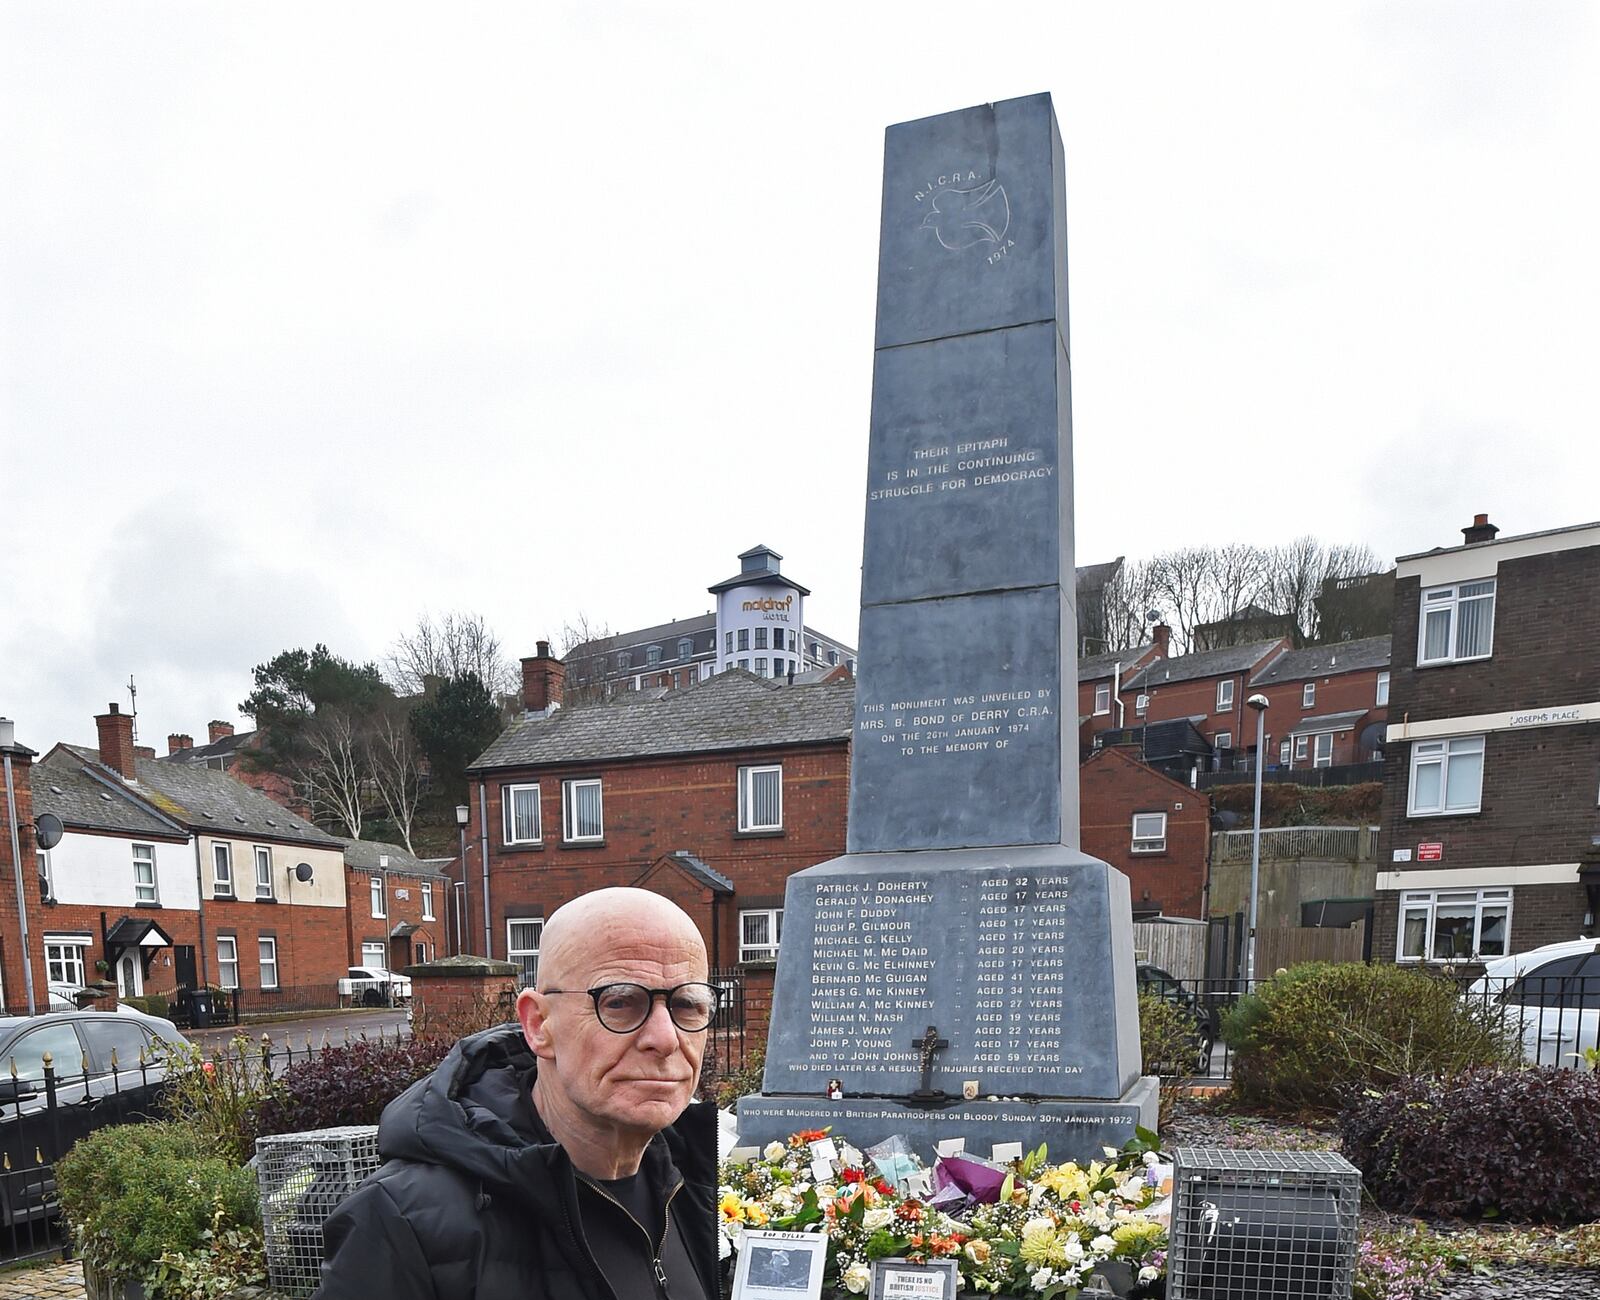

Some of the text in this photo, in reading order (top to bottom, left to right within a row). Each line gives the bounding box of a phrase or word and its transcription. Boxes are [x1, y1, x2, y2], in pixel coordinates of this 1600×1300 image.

[986, 239, 1015, 266] 1974
[913, 438, 1009, 459] THEIR EPITAPH
[887, 451, 1036, 481] IS IN THE CONTINUING
[870, 466, 1055, 501] STRUGGLE FOR DEMOCRACY
[863, 689, 1052, 713] THIS MONUMENT WAS UNVEILED BY
[860, 706, 1053, 730] MRS. B. BOND OF DERRY C.R.A.
[1552, 711, 1575, 720] PLACE
[881, 724, 1030, 743] ON THE 26TH JANUARY 1974
[901, 740, 1009, 756] TO THE MEMORY OF
[816, 877, 1069, 893] PATRICK J. DOHERTY AGED 32 YEARS
[815, 890, 1068, 907] GERALD V. DONAGHEY AGED 17 YEARS
[815, 904, 1066, 920] JOHN F. DUDDY AGED 17 YEARS
[814, 918, 1065, 932] HUGH P. GILMOUR AGED 17 YEARS
[814, 936, 860, 946] MICHAEL
[864, 935, 876, 944] G.
[880, 934, 913, 944] KELLY
[1013, 932, 1025, 941] 17
[1031, 932, 1065, 940] YEARS
[813, 949, 859, 958] MICHAEL
[863, 948, 877, 957] M.
[902, 947, 928, 956] DAID
[978, 947, 1005, 955] AGED
[1012, 946, 1025, 954] 20
[1031, 946, 1064, 954] YEARS
[812, 962, 843, 971] KEVIN
[847, 961, 859, 970] G.
[884, 960, 936, 969] ELHINNEY
[977, 960, 1005, 968] AGED
[1011, 959, 1023, 968] 17
[1030, 959, 1063, 967] YEARS
[812, 975, 861, 984] BERNARD
[886, 974, 928, 983] GUIGAN
[1011, 973, 1023, 981] 41
[1030, 973, 1064, 981] YEARS
[811, 988, 846, 997] JAMES
[850, 987, 861, 996] G.
[887, 987, 926, 996] KINNEY
[977, 987, 1004, 995] AGED
[1010, 986, 1023, 995] 34
[1030, 986, 1063, 994] YEARS
[811, 1001, 854, 1009] WILLIAM
[858, 1000, 870, 1009] A.
[895, 1000, 935, 1009] KINNEY
[976, 1000, 1003, 1008] AGED
[1010, 1000, 1022, 1008] 27
[1029, 1000, 1062, 1008] YEARS
[810, 1013, 1061, 1022] WILLIAM N. NASH AGED 19 YEARS
[810, 1026, 1061, 1035] JAMES J. WRAY AGED 22 YEARS
[810, 1039, 1059, 1048] JOHN P. YOUNG AGED 17 YEARS
[851, 1053, 879, 1061] JOHN
[883, 1053, 940, 1061] JOHNSN
[1007, 1053, 1020, 1061] 59
[1027, 1054, 1060, 1062] YEARS
[941, 1065, 984, 1073] INJURIES
[786, 1109, 830, 1117] MURDERED
[846, 1110, 878, 1118] BRITISH
[881, 1112, 946, 1120] PARATROOPERS
[963, 1112, 998, 1121] BLOODY
[1002, 1113, 1036, 1122] SUNDAY
[1039, 1114, 1061, 1123] 30TH
[1064, 1115, 1105, 1124] JANUARY
[1109, 1116, 1132, 1124] 1972
[889, 1283, 914, 1291] BRITISH
